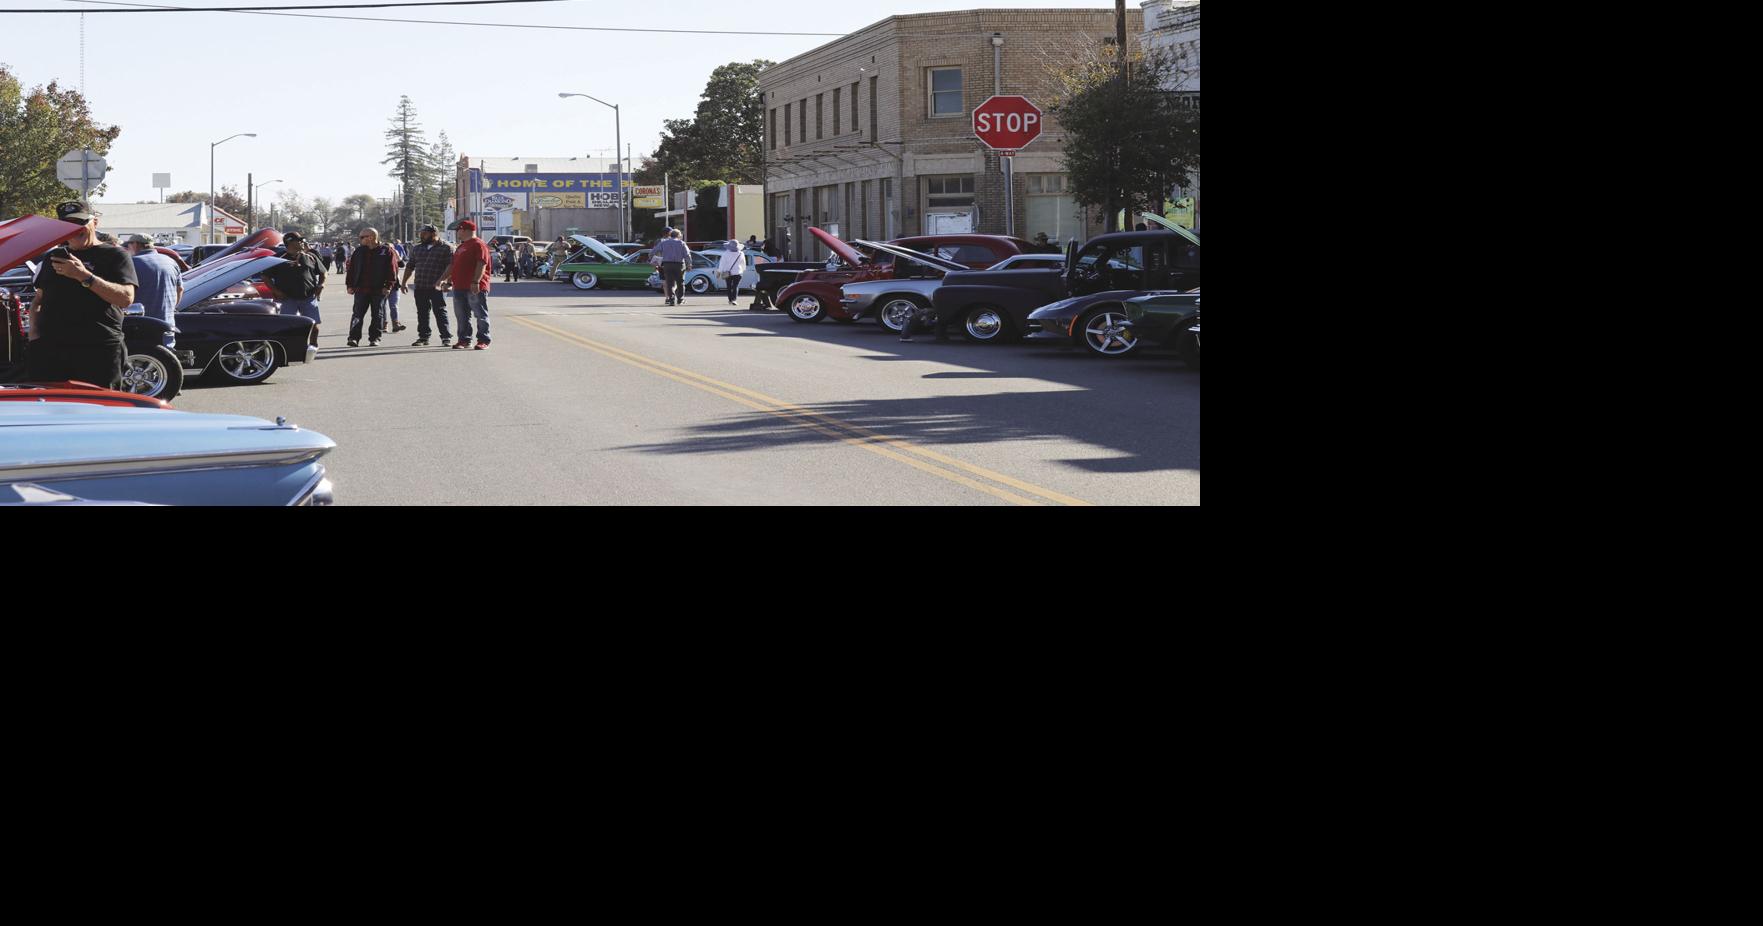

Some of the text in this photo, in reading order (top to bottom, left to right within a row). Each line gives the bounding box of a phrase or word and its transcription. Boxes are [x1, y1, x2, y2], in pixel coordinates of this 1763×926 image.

[976, 112, 1038, 133] STOP
[497, 179, 548, 188] HOME
[552, 180, 575, 188] OF
[580, 180, 613, 188] THE
